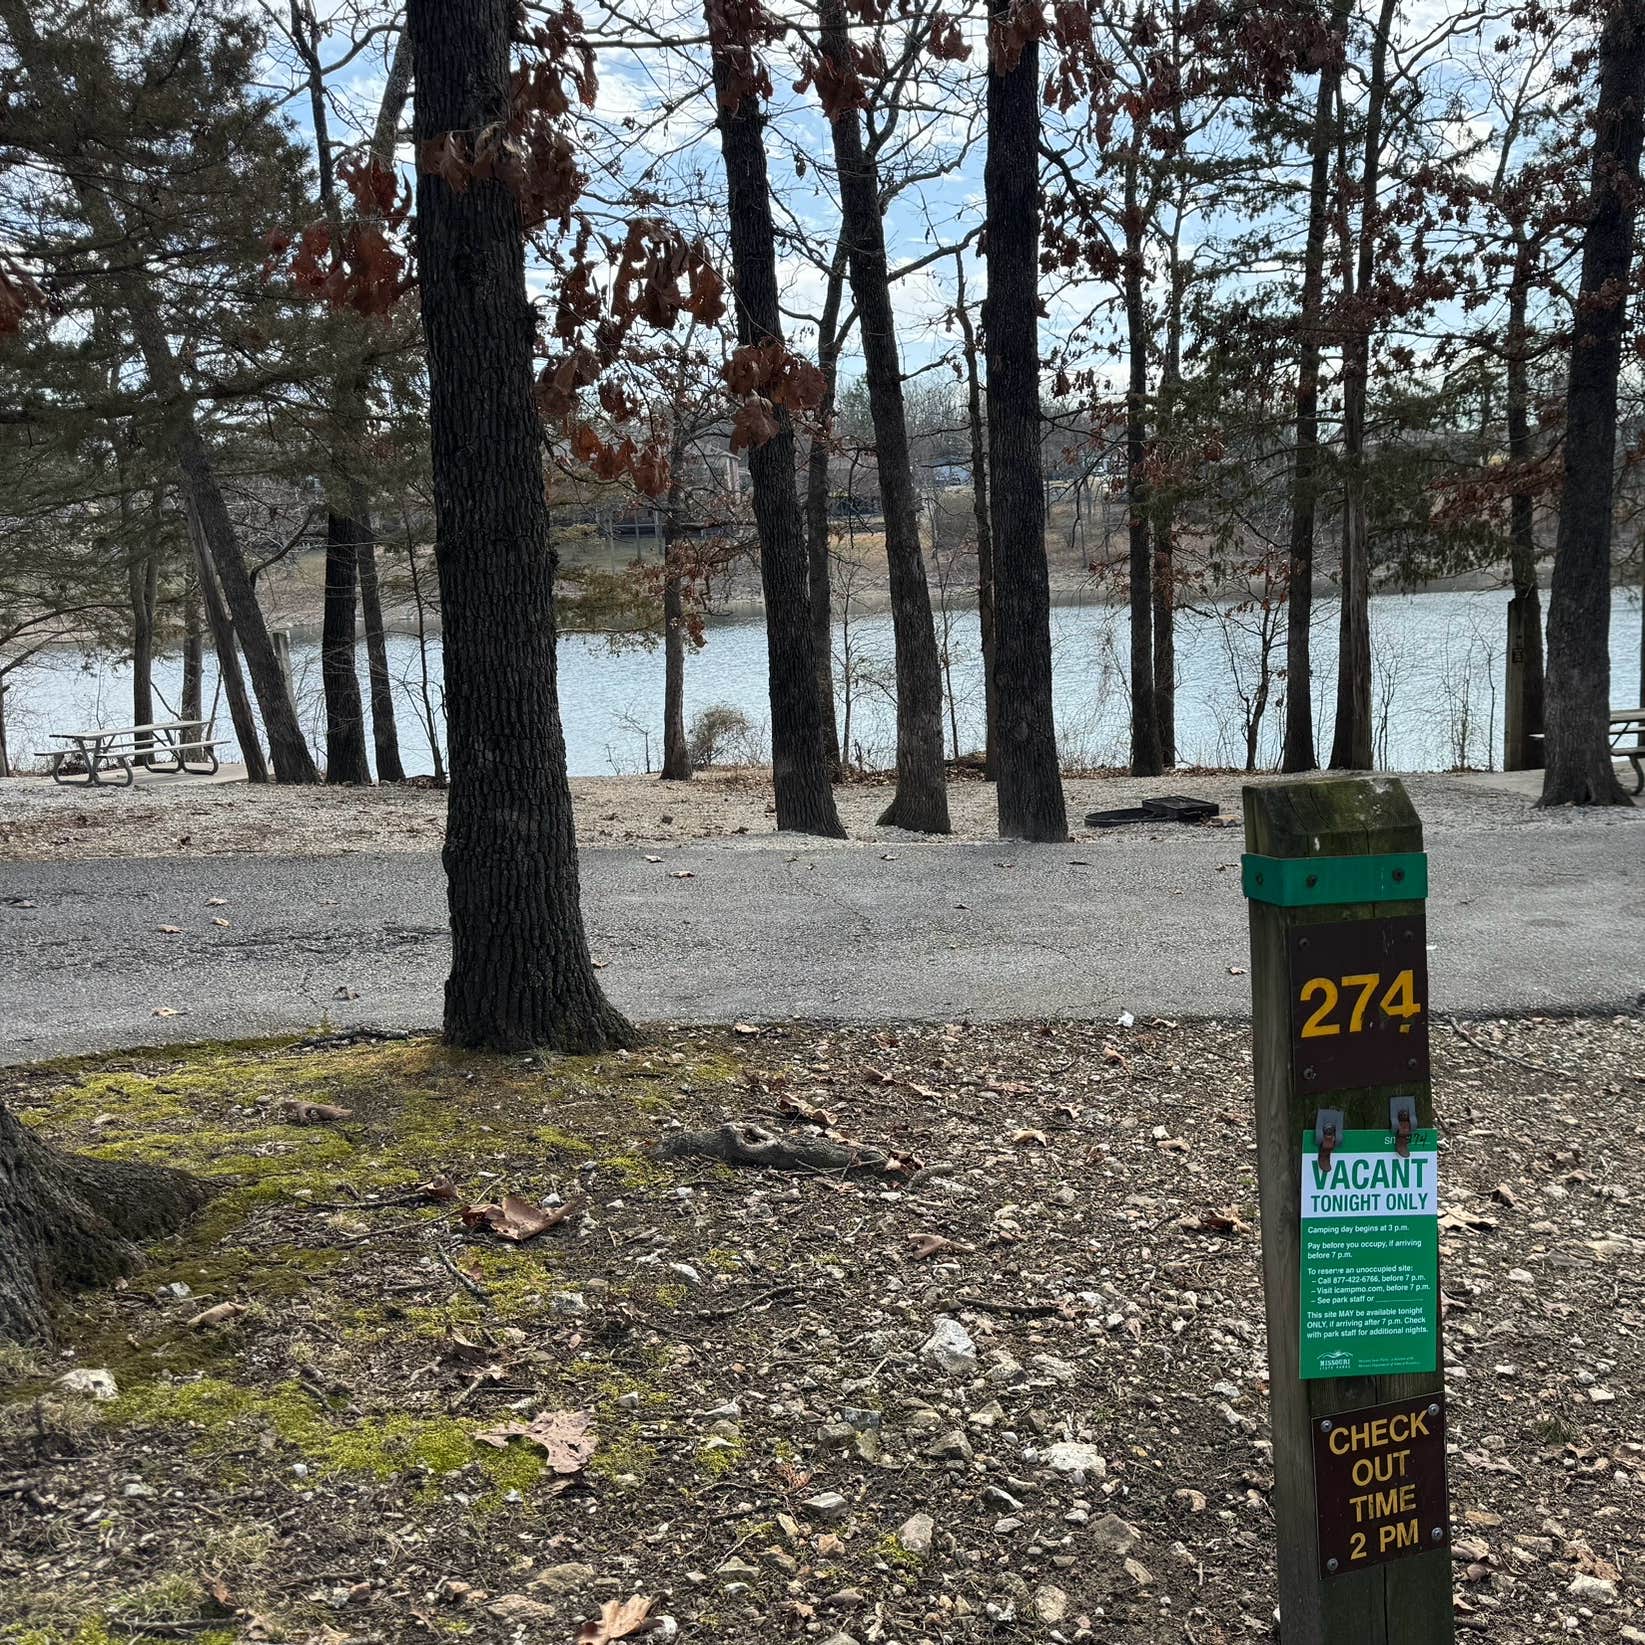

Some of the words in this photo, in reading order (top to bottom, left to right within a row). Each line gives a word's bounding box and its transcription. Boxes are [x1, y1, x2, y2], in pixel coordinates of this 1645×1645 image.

[1300, 970, 1421, 1038] 274
[1311, 1158, 1428, 1190] VACANT
[1311, 1194, 1380, 1212] TONIGHT
[1386, 1193, 1428, 1211] ONLY
[1307, 1226, 1339, 1234] Camping
[1340, 1225, 1354, 1233] day
[1355, 1224, 1378, 1233] begins
[1307, 1242, 1320, 1250] Pay
[1338, 1252, 1352, 1260] p.m.
[1356, 1265, 1397, 1274] unoccupied
[1381, 1274, 1404, 1282] before
[1386, 1284, 1408, 1292] before
[1332, 1296, 1348, 1304] park
[1307, 1311, 1322, 1319] This
[1366, 1308, 1397, 1316] available
[1398, 1307, 1423, 1315] tonight
[1307, 1321, 1328, 1329] ONLY,
[1336, 1320, 1363, 1328] arriving
[1404, 1316, 1426, 1324] Check
[1323, 1330, 1339, 1339] park
[1369, 1327, 1403, 1335] additional
[1329, 1410, 1430, 1455] CHECK
[1352, 1450, 1410, 1486] OUT
[1349, 1484, 1416, 1522] TIME
[1350, 1532, 1367, 1560] 2
[1379, 1518, 1419, 1552] PM
